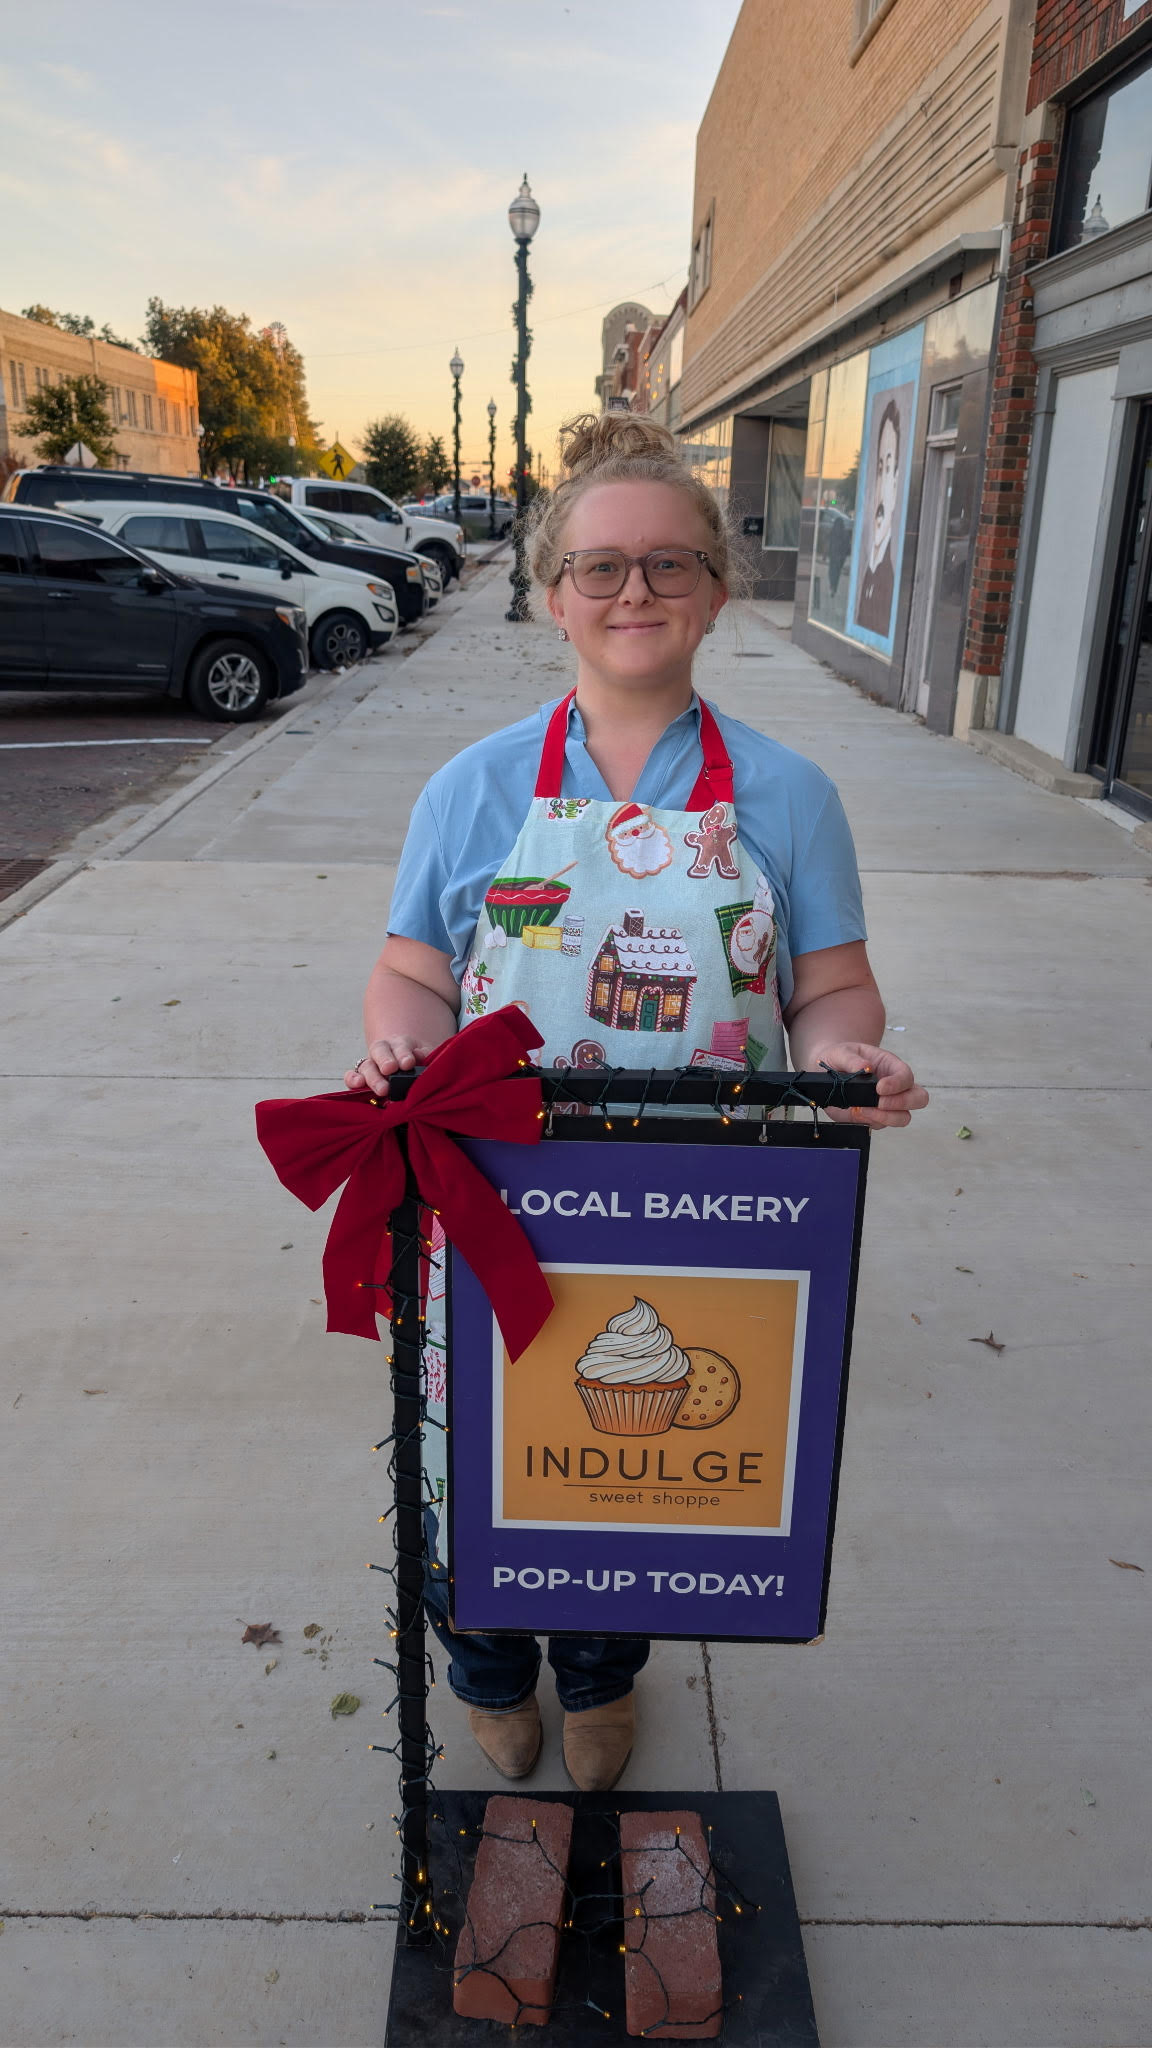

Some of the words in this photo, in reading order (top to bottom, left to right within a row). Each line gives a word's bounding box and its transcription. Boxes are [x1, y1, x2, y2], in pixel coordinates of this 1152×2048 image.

[500, 1188, 632, 1218] LOCAL
[643, 1192, 810, 1223] BAKERY
[526, 1445, 764, 1484] INDULGE
[589, 1492, 644, 1504] sweet
[652, 1492, 721, 1508] shoppe
[492, 1566, 637, 1592] POP-UP
[646, 1571, 785, 1597] TODAY!
